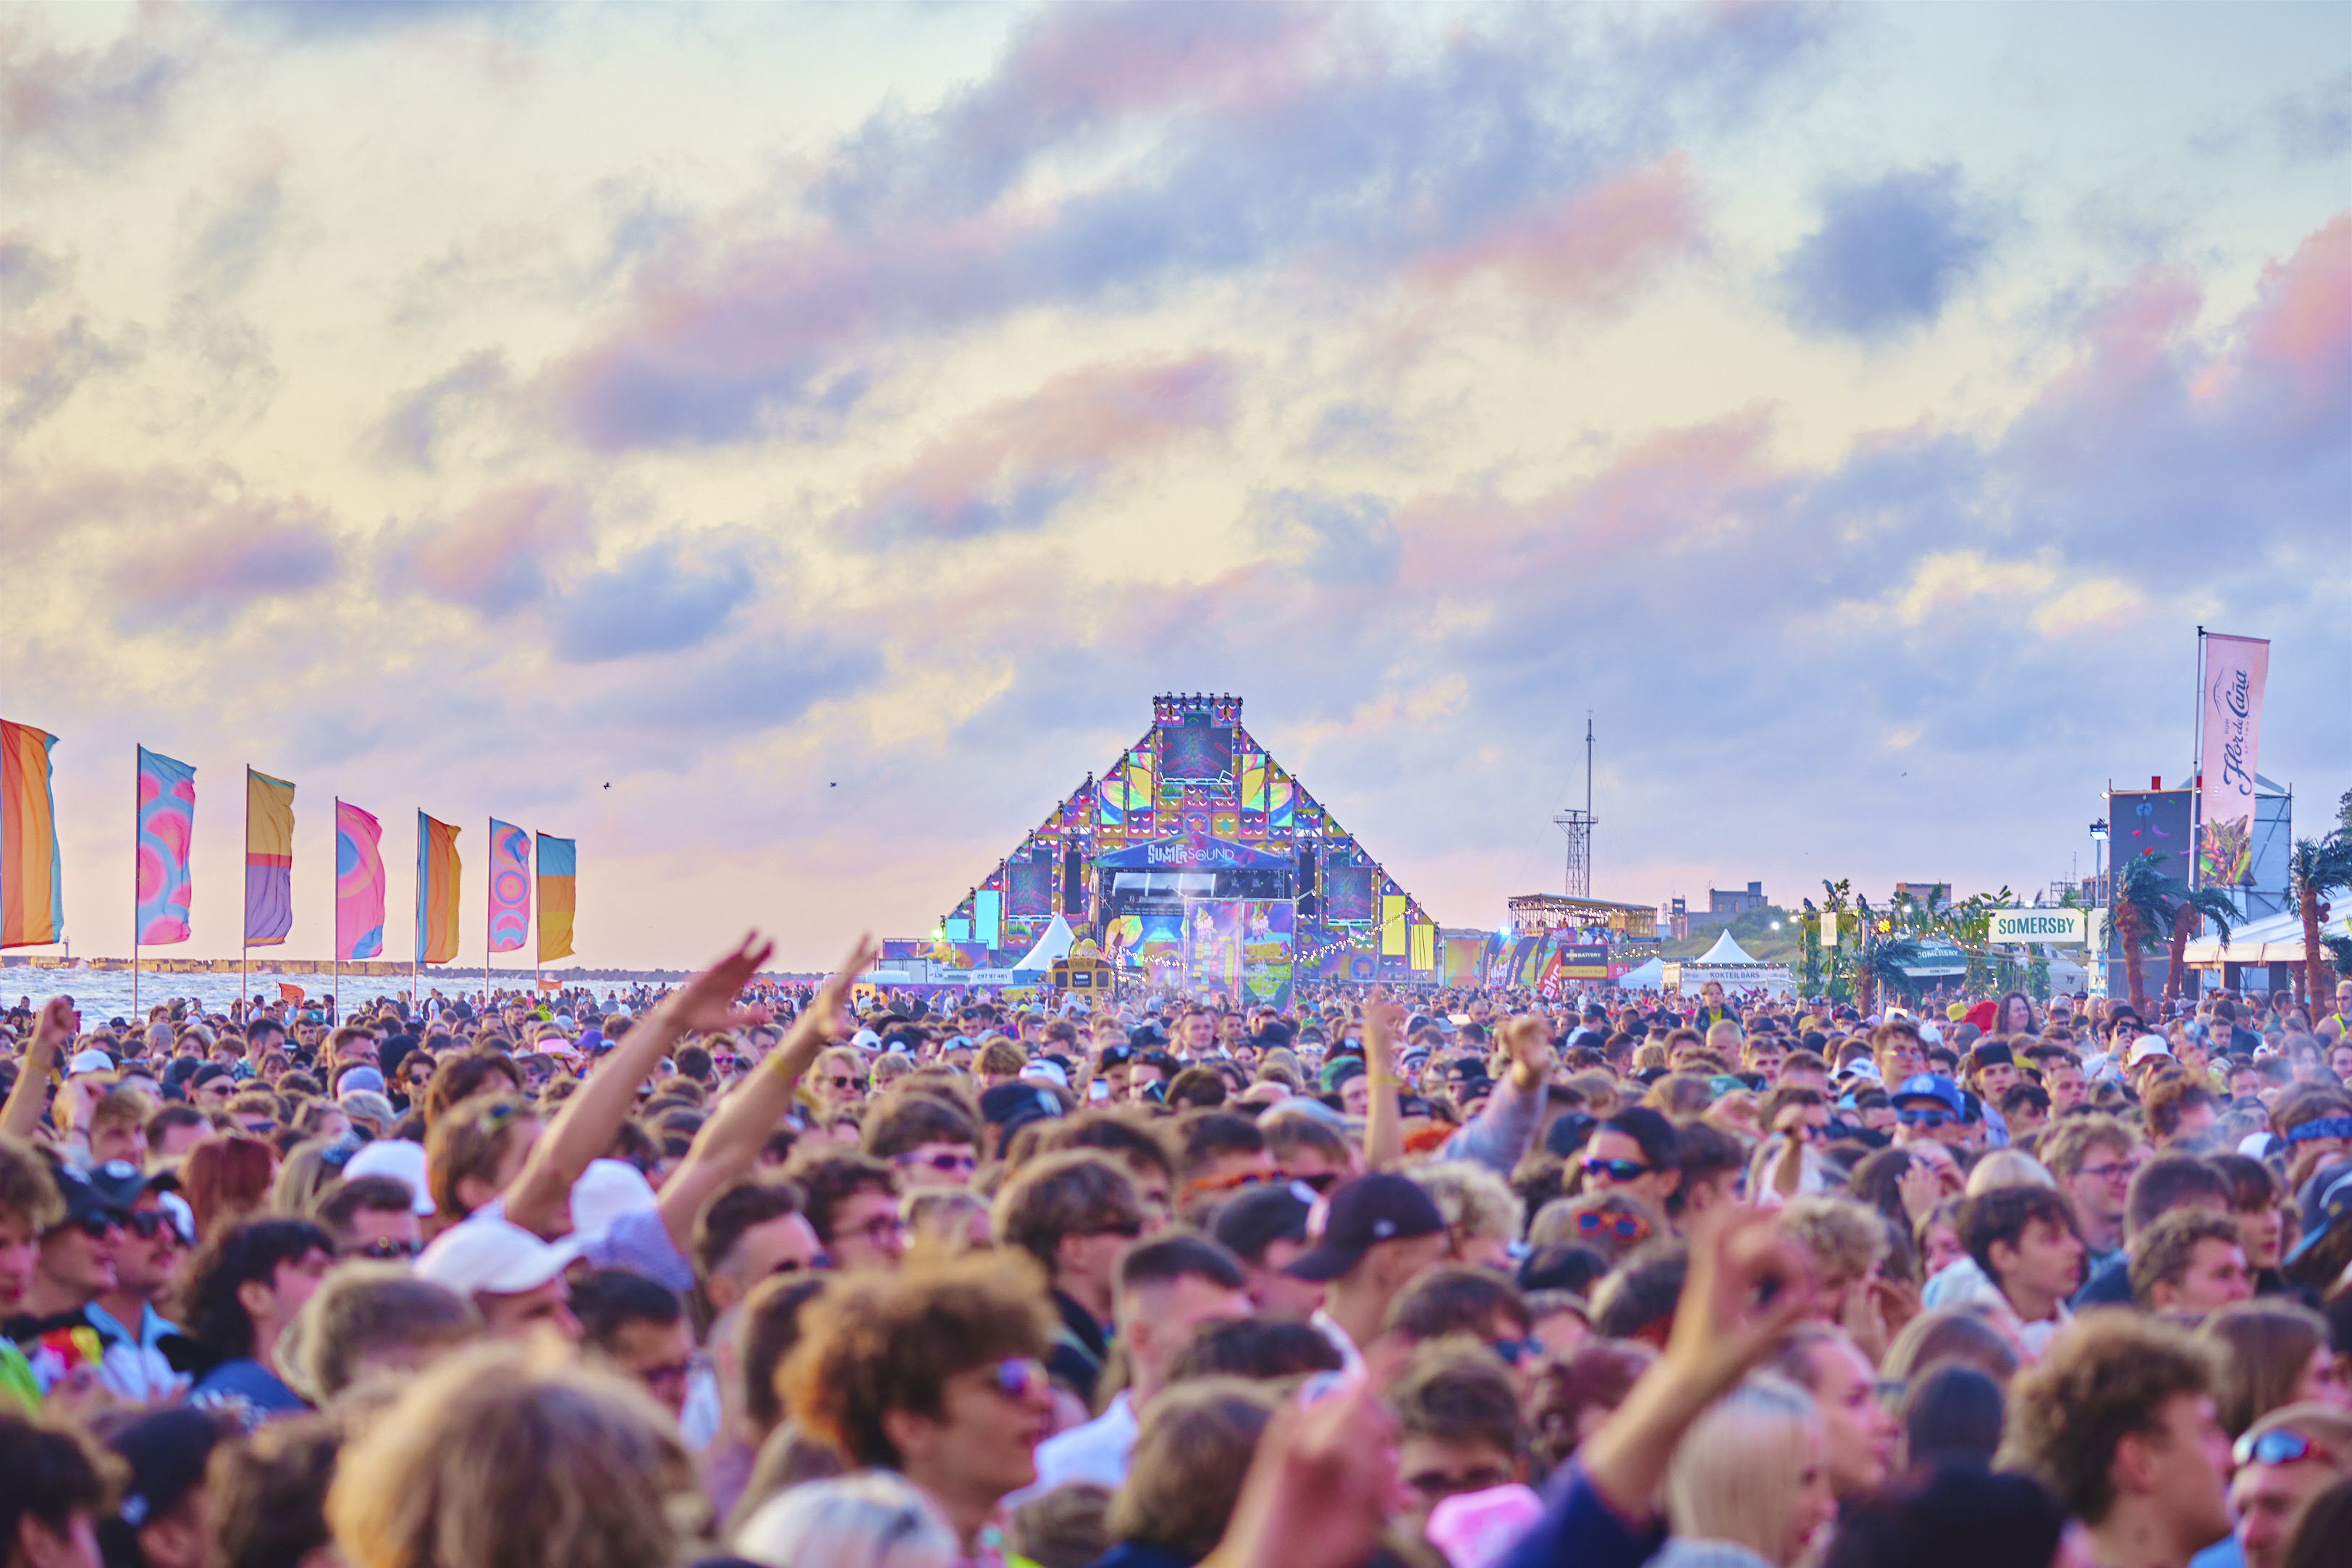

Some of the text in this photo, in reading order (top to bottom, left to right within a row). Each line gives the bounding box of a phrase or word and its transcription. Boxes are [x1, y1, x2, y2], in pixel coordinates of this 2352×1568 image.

[2225, 670, 2249, 718] Caña
[2233, 718, 2243, 735] de
[1998, 917, 2074, 934] SOMERSBY
[1917, 950, 1958, 958] SOMERSBY
